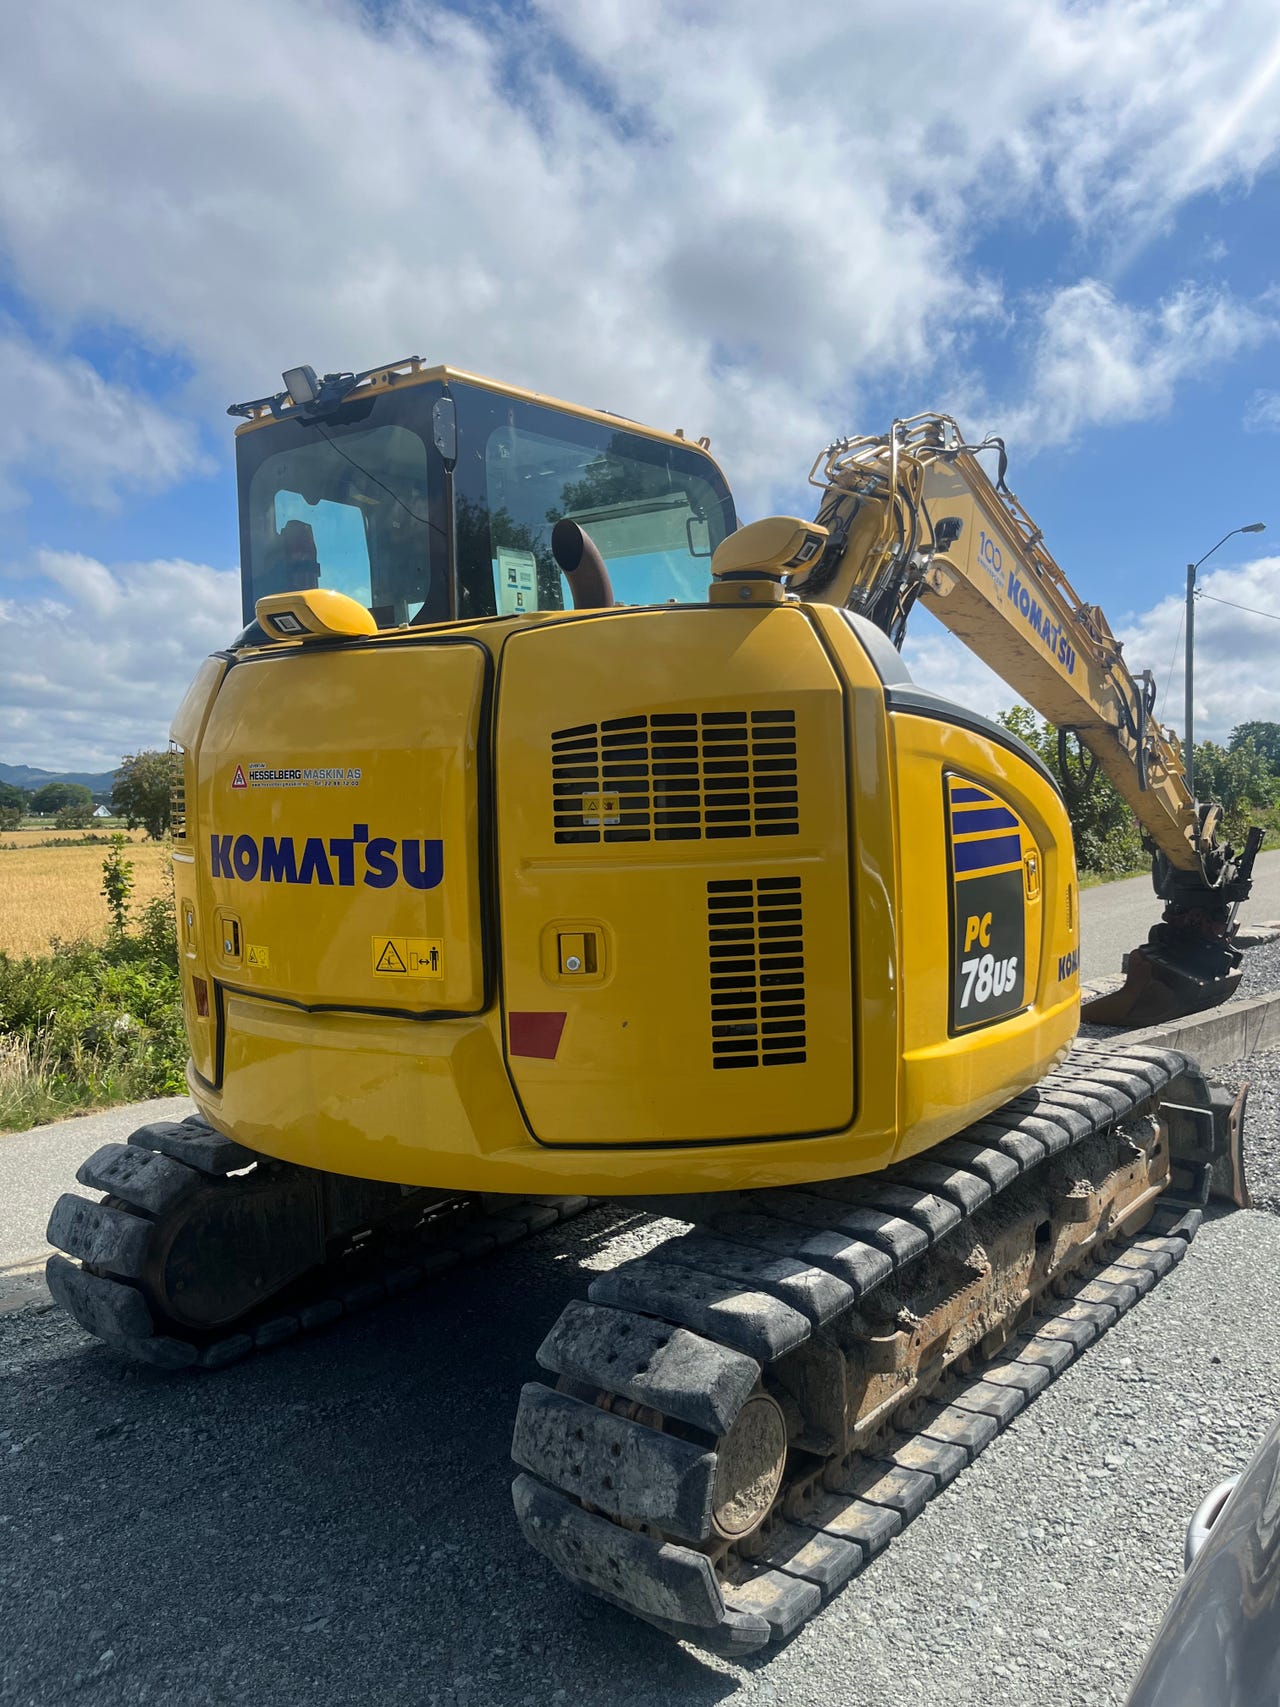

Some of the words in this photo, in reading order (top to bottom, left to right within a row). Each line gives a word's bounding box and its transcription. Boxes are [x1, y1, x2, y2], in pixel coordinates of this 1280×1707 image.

[980, 531, 1002, 572] 100
[1007, 571, 1076, 675] KOMATSU
[249, 769, 301, 781] HESSELBERG
[303, 768, 344, 780] MASKIN
[346, 768, 362, 779] AS
[210, 823, 444, 889] KOMATSU
[964, 912, 992, 952] PC
[960, 953, 1018, 1009] 78US
[1058, 945, 1080, 982] KOM
